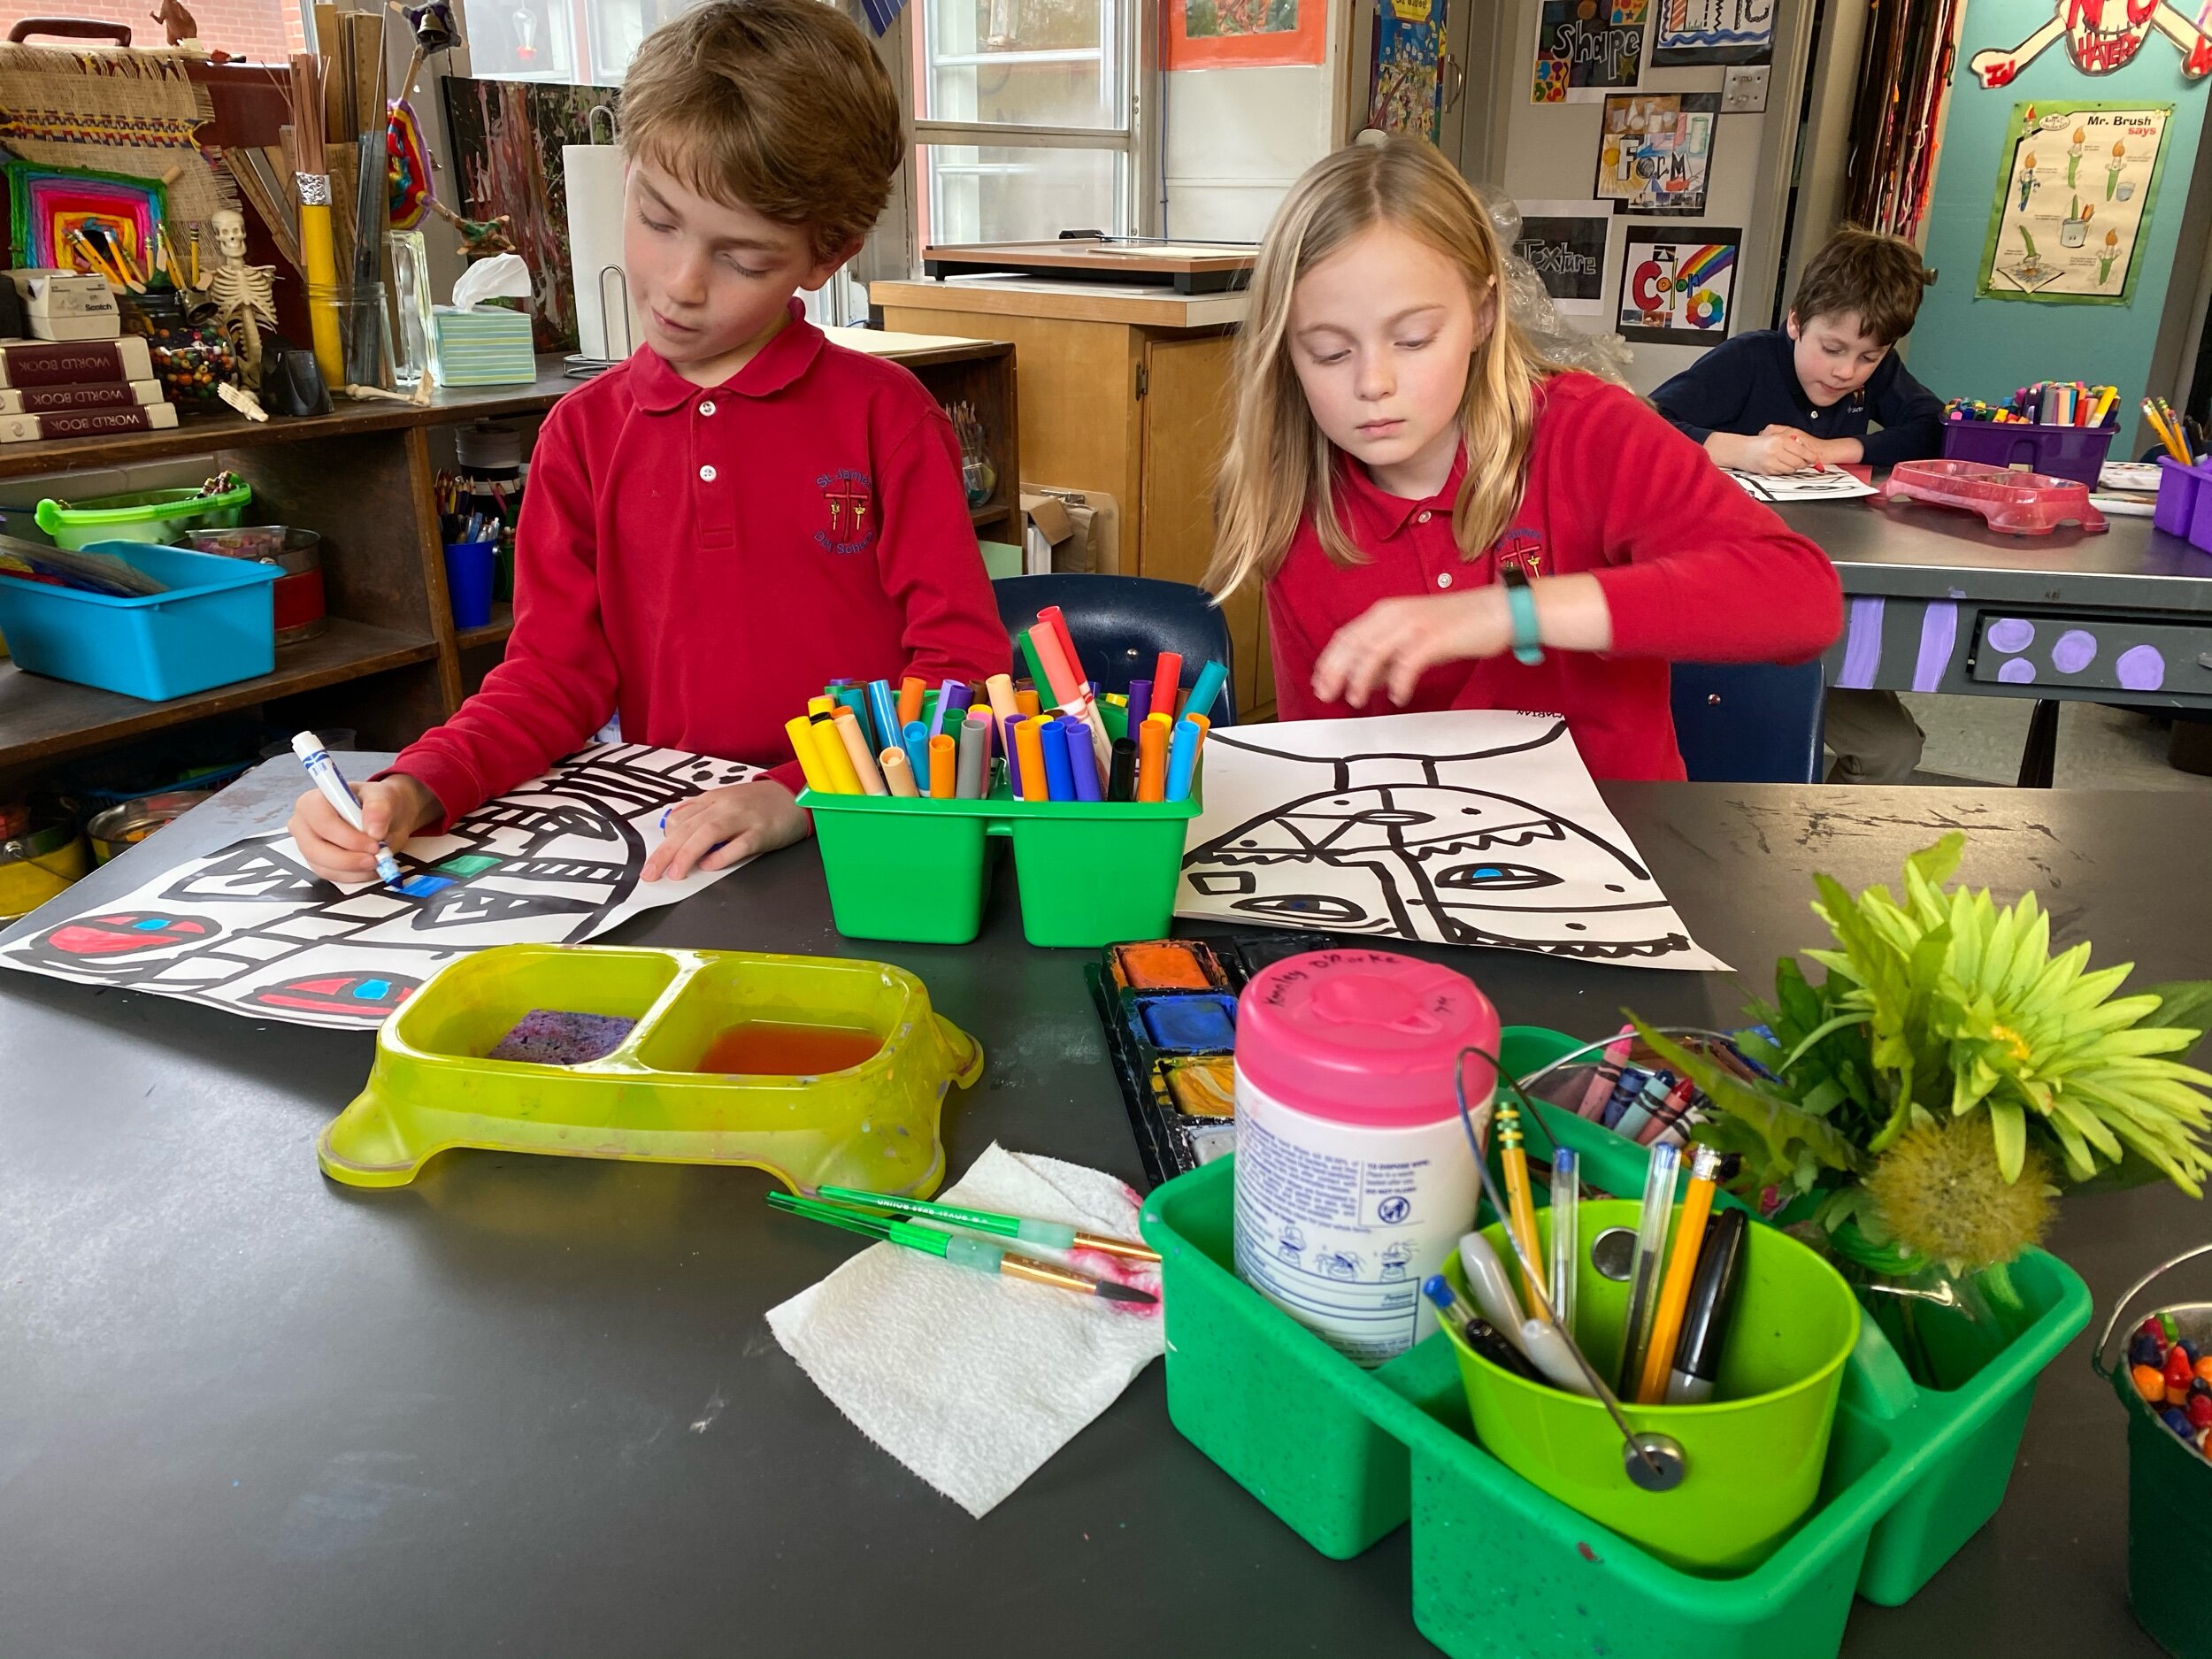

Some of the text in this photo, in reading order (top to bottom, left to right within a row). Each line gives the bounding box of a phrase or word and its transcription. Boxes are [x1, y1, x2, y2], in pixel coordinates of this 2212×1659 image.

[1550, 19, 1640, 81] Shape
[2087, 115, 2152, 126] Mr. Brush
[2127, 127, 2157, 138] says
[1514, 238, 1596, 275] Texture
[1632, 257, 1700, 311] Color
[19, 357, 111, 373] WORLD BOOK
[33, 388, 124, 406] WORLD BOOK
[50, 413, 140, 432] WORLD BOOK
